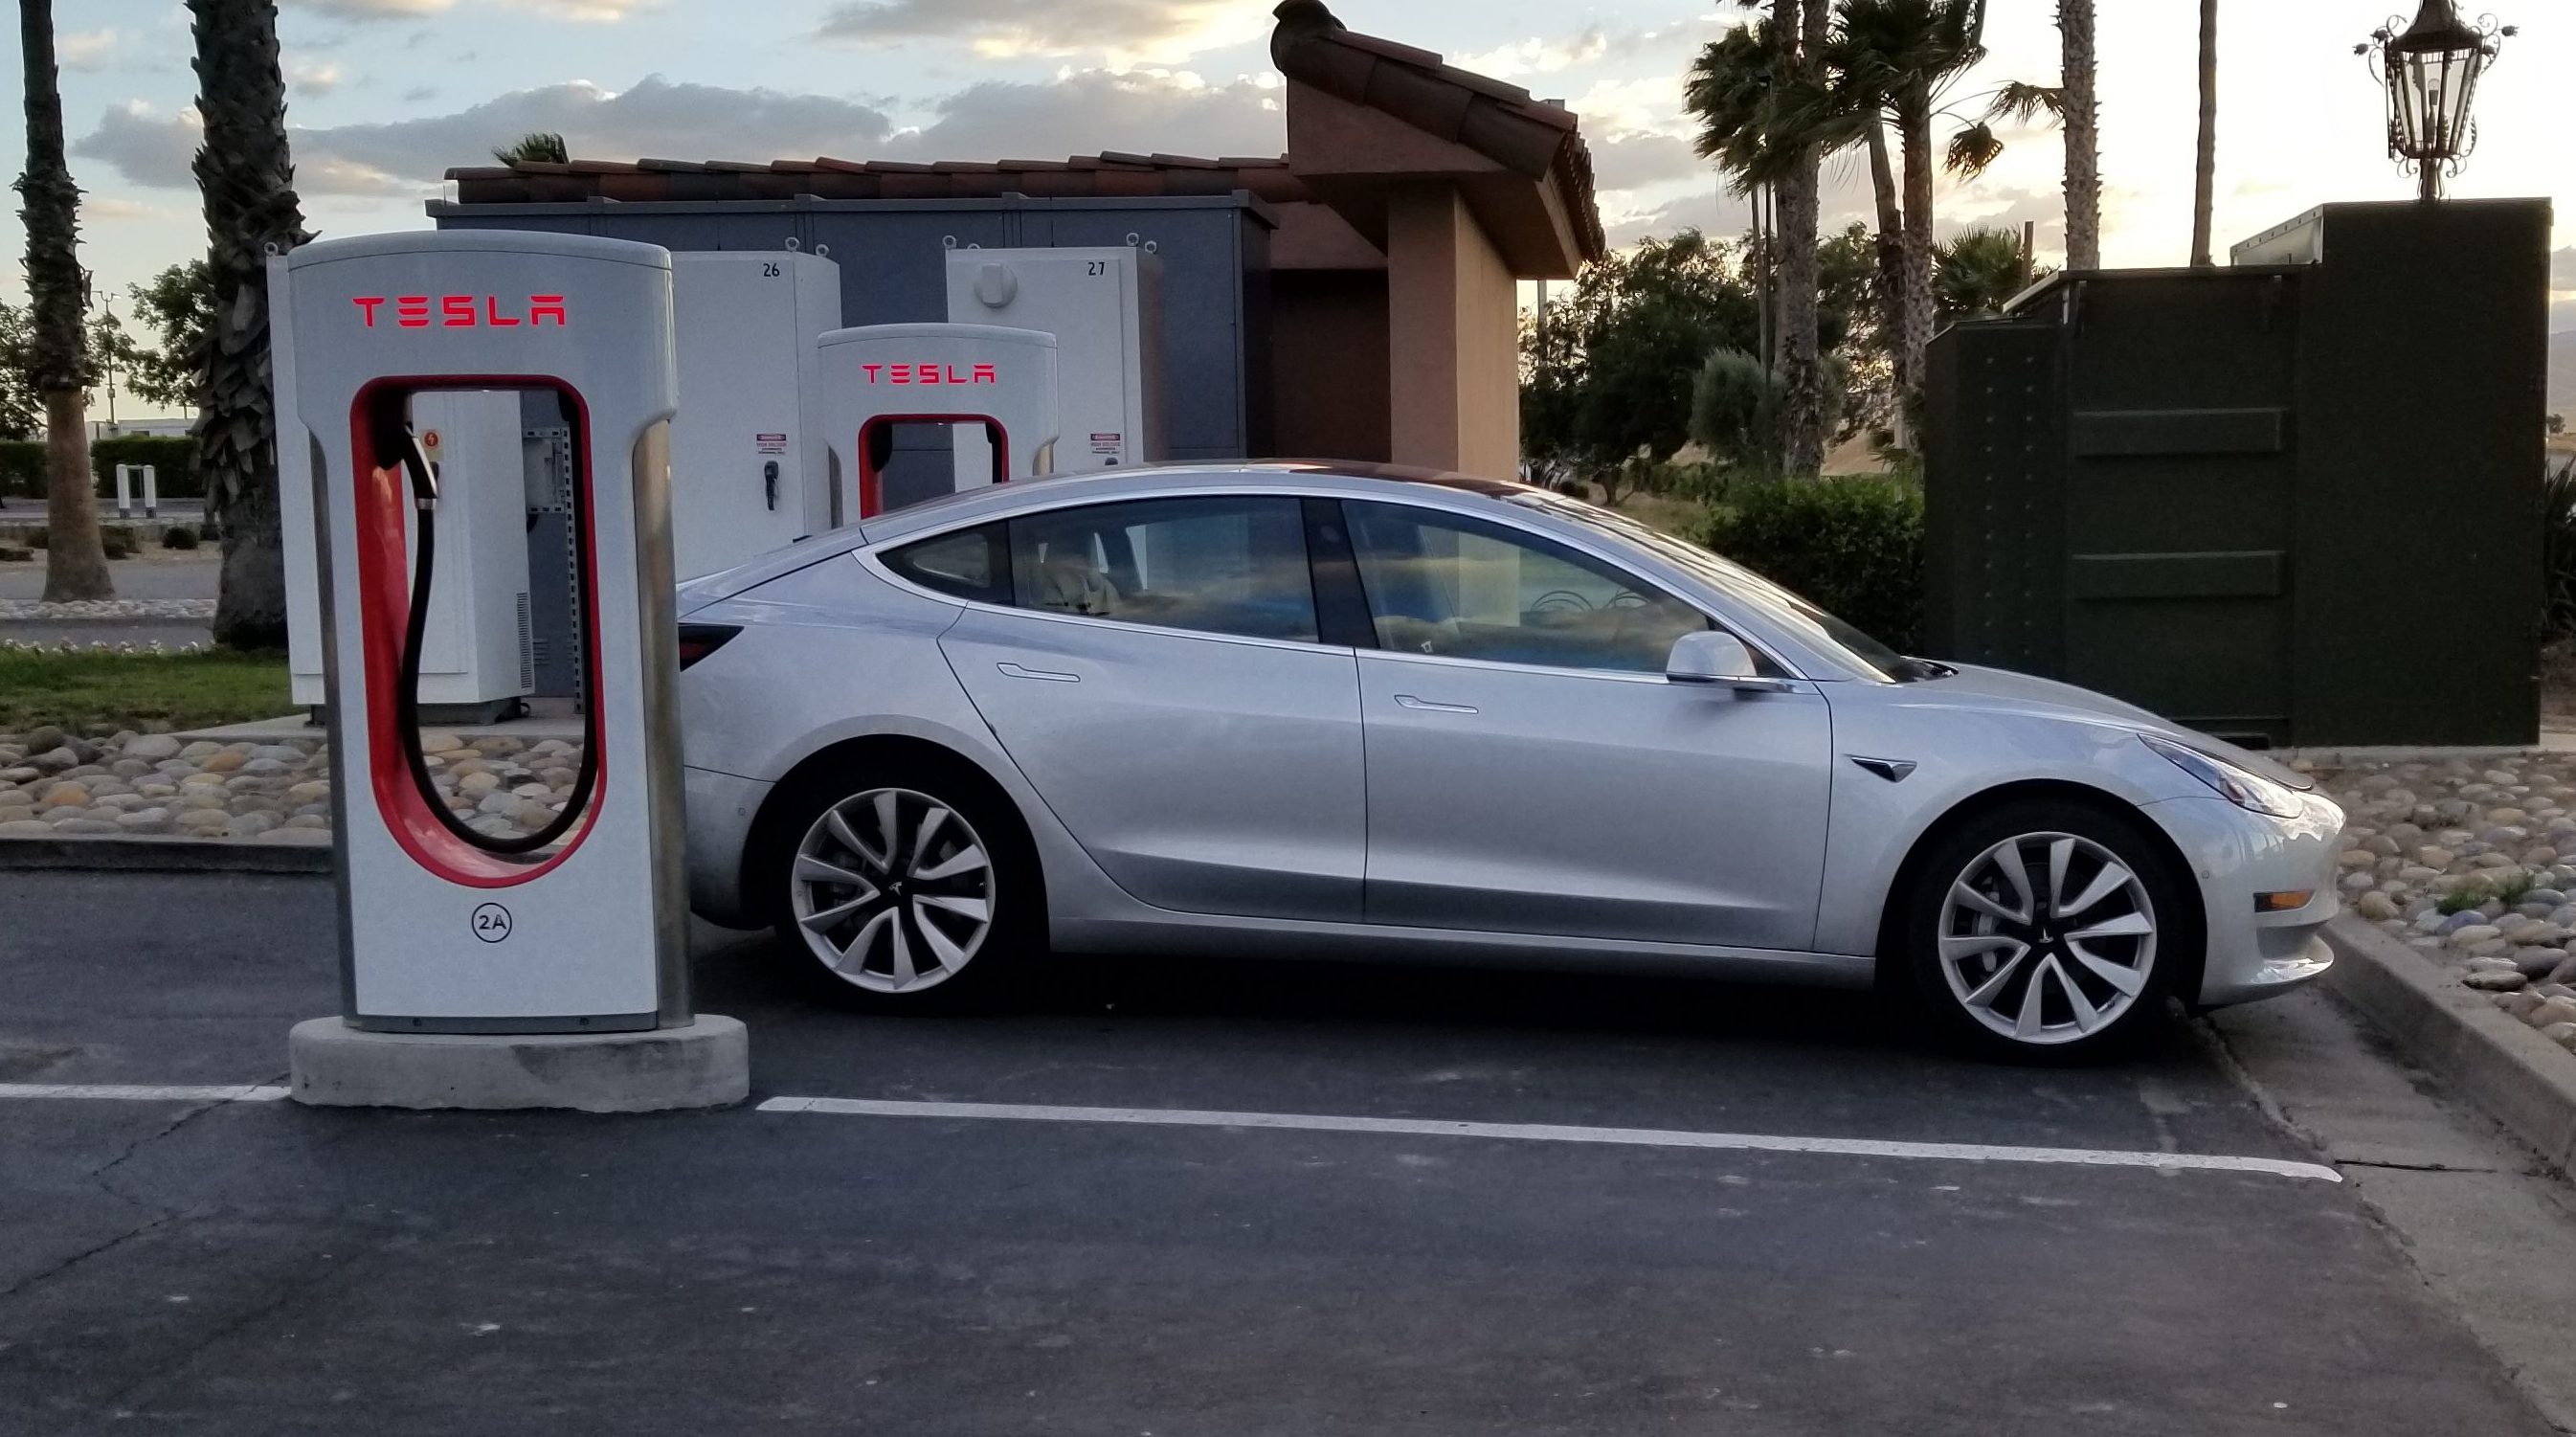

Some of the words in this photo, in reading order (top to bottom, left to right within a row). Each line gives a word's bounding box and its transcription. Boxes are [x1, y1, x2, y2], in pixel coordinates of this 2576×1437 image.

[763, 262, 780, 278] 26
[1087, 261, 1106, 277] 27
[352, 295, 566, 327] TESLA
[862, 364, 996, 385] TESLA
[479, 913, 507, 930] 2A
